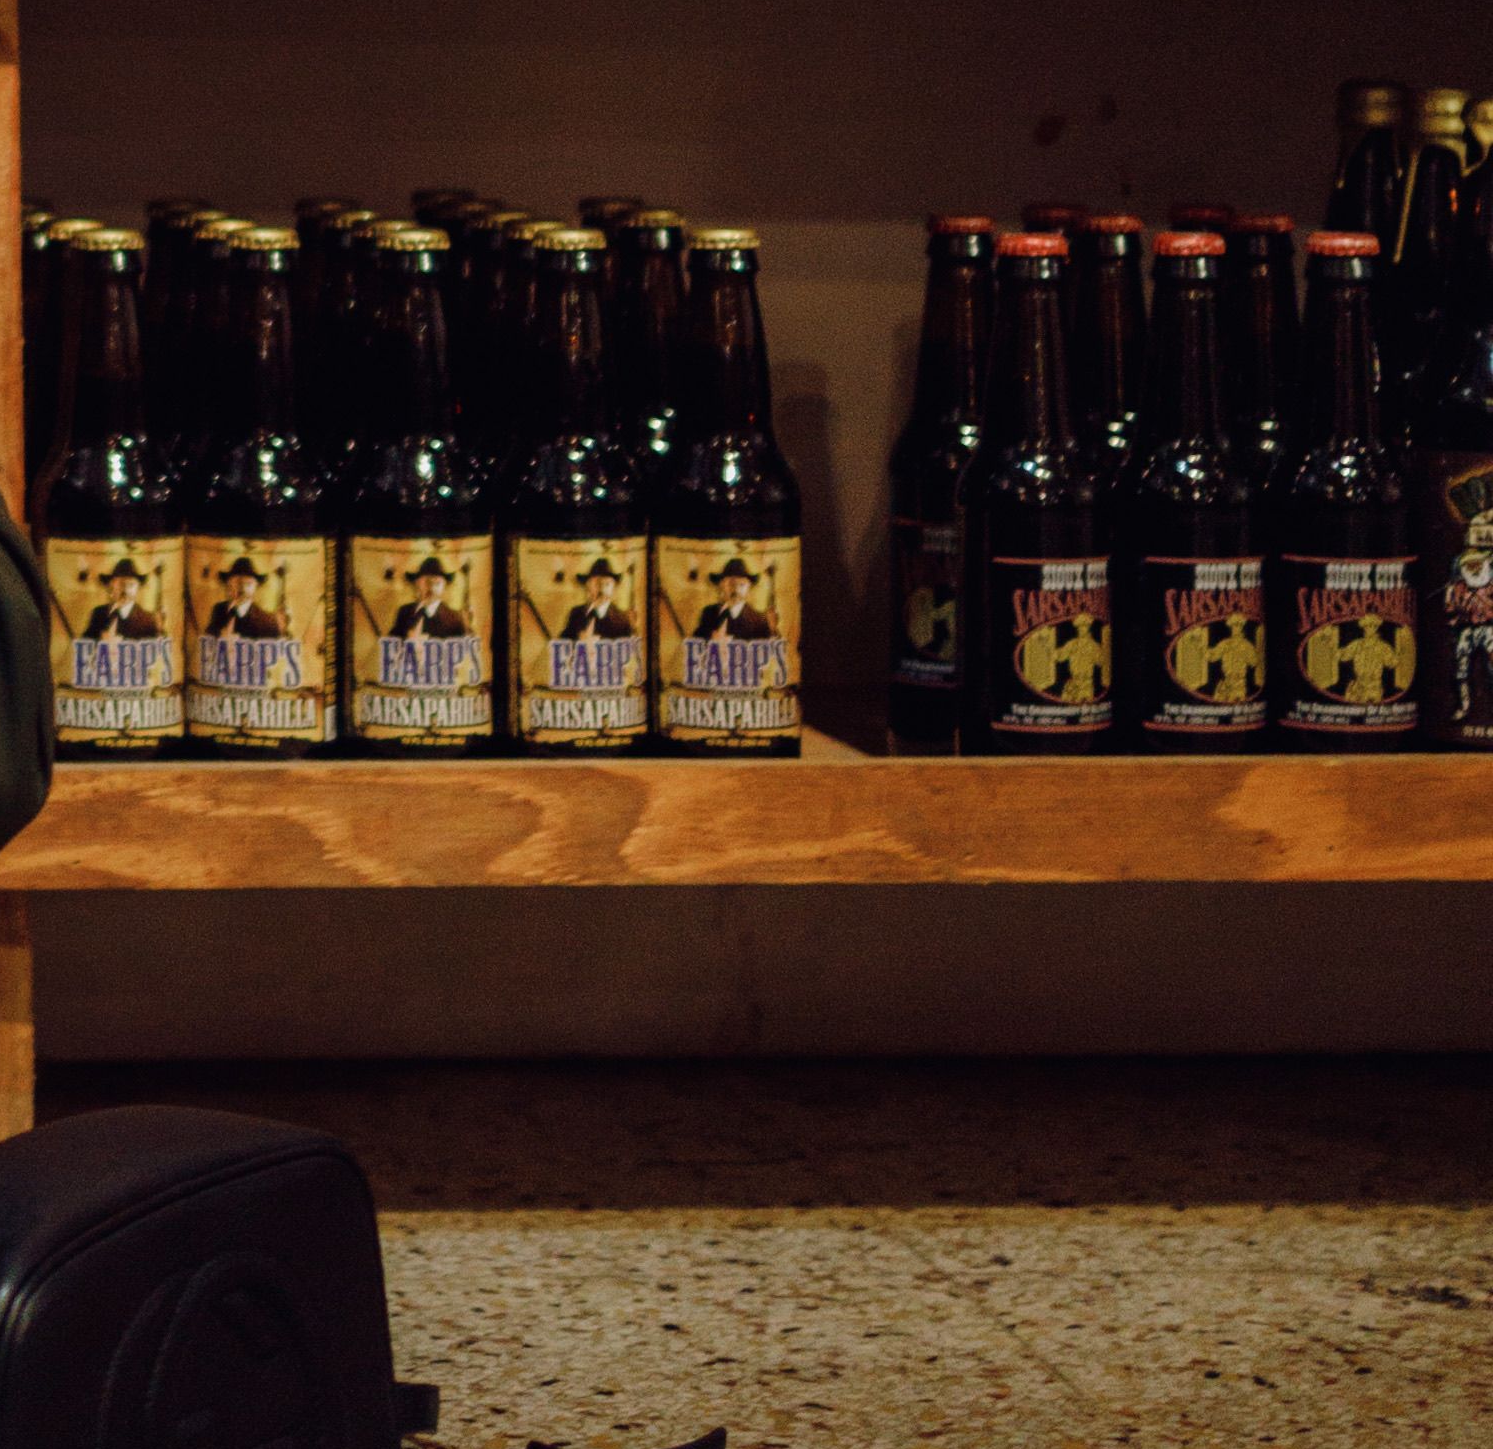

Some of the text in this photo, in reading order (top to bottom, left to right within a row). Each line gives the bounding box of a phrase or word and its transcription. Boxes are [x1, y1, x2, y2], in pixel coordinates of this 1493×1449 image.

[74, 638, 173, 689] EARP'S
[199, 637, 301, 688] EARP'S
[379, 636, 483, 688] EARP'S
[549, 637, 646, 689] EARP'S
[683, 636, 789, 688] EARP'S
